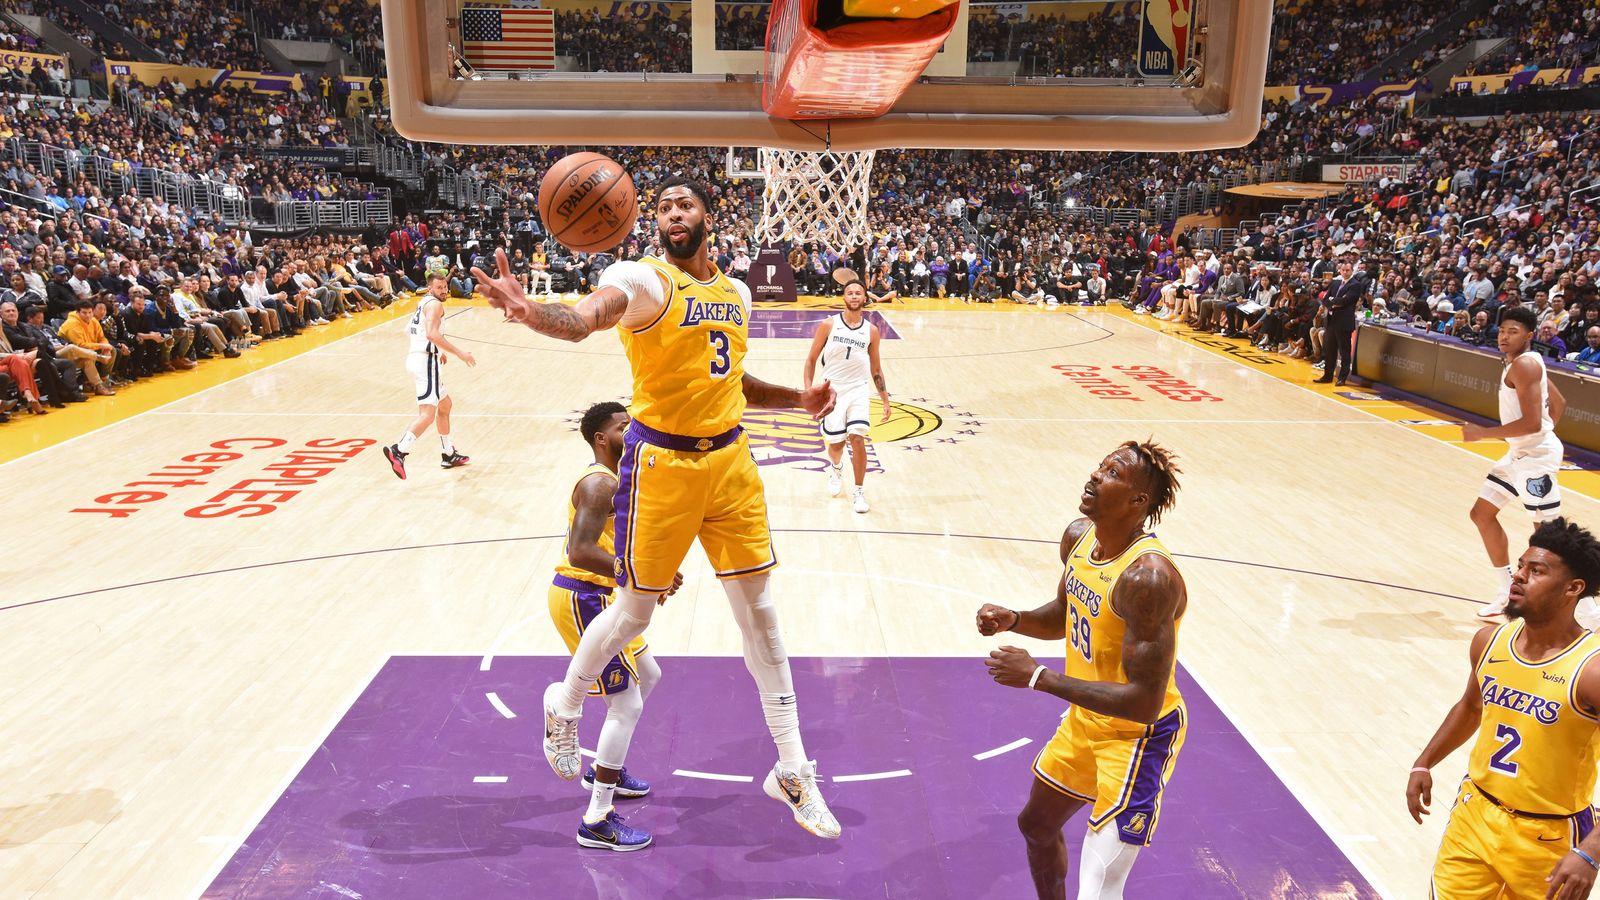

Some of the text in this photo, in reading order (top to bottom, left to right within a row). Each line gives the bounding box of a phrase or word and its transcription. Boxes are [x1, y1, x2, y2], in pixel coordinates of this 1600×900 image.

[1144, 50, 1168, 70] NBA
[556, 165, 616, 222] SPALDING
[679, 296, 744, 328] LAKERS
[709, 329, 731, 376] 3
[832, 335, 866, 348] MEMPHIS
[845, 345, 852, 360] 1
[1051, 364, 1145, 401] Center
[1112, 365, 1224, 402] STAPLES
[1393, 355, 1425, 375] RESORTS
[1443, 370, 1479, 390] WELCOME
[1482, 380, 1490, 393] TO
[69, 437, 288, 518] Center
[183, 437, 378, 519] STAPLES
[1069, 602, 1092, 662] 39
[1542, 670, 1566, 685] wish
[1481, 674, 1562, 725] LAKERS
[1489, 723, 1522, 778] 2
